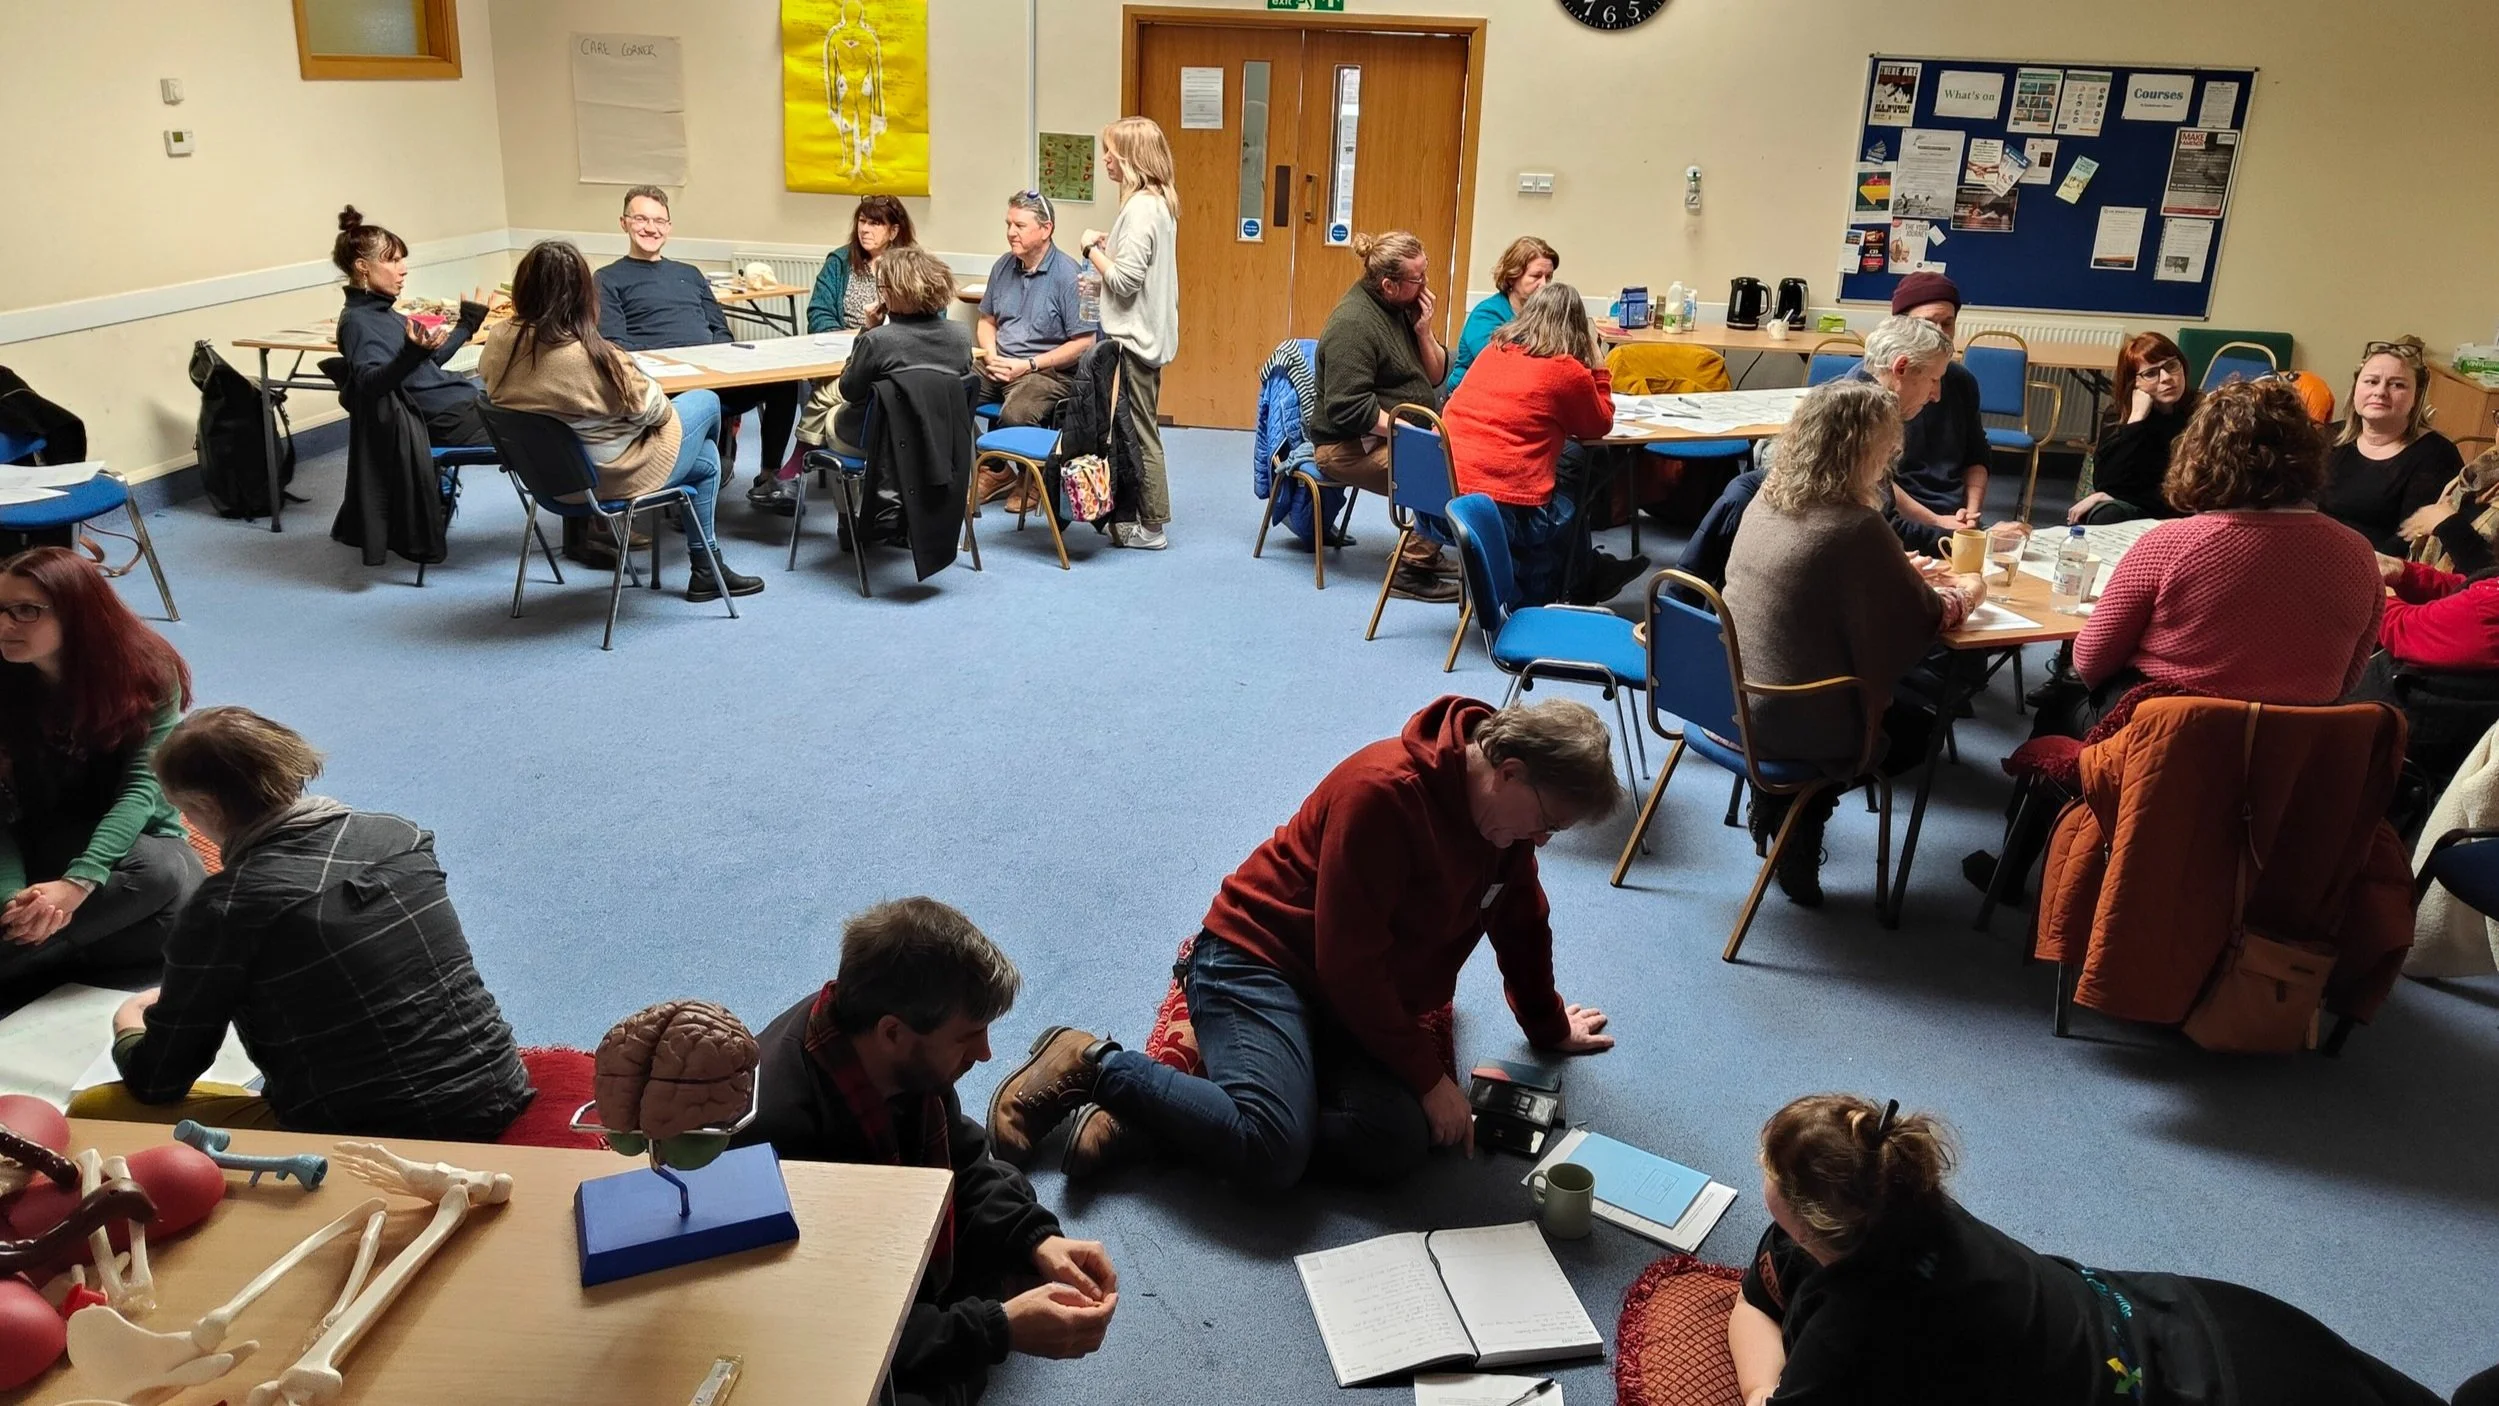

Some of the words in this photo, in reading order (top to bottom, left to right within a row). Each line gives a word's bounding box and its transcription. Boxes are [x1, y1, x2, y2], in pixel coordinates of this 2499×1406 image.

[1584, 0, 1596, 16] 7
[1603, 5, 1616, 23] 6
[1626, 1, 1640, 19] 5
[1945, 89, 1980, 100] What's
[2134, 88, 2184, 100] Courses
